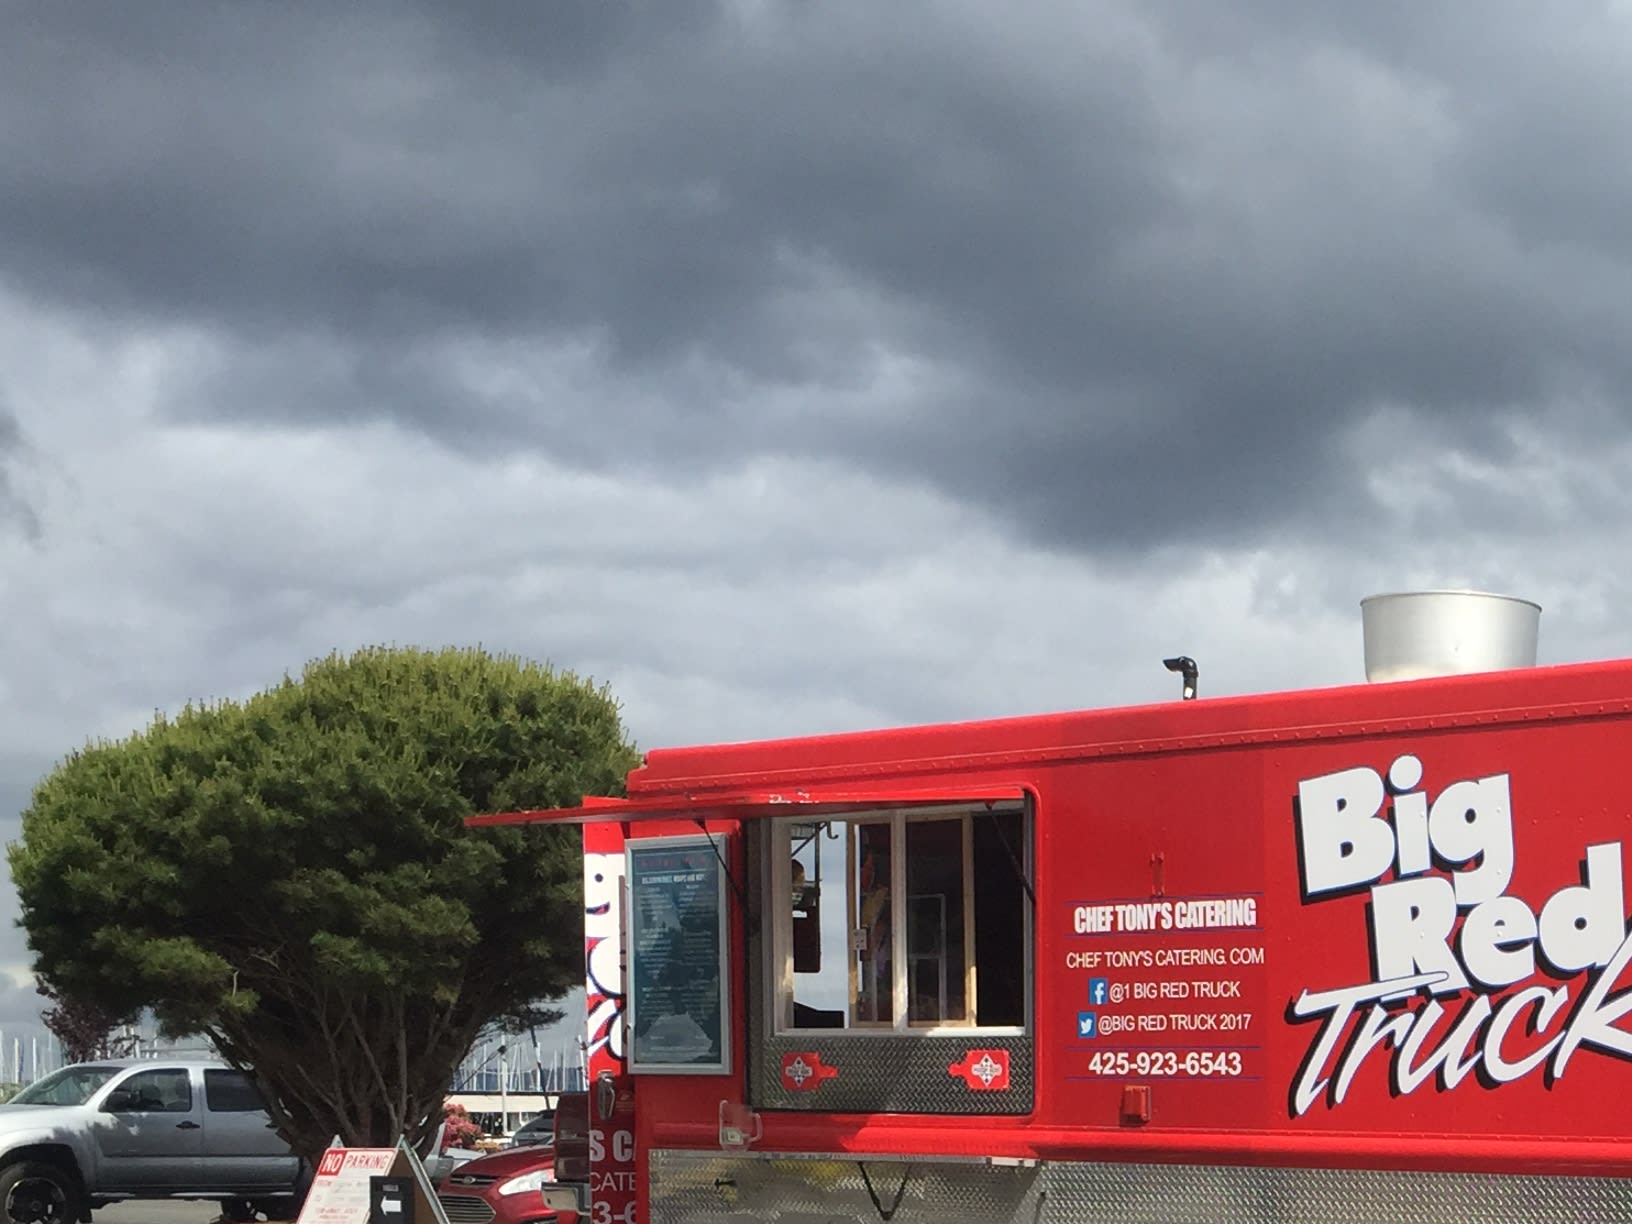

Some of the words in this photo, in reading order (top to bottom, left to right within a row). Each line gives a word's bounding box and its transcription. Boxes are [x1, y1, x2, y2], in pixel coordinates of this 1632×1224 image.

[1297, 754, 1514, 905] Big
[1074, 905, 1114, 934] CHEF
[1115, 902, 1173, 932] TONY'S
[1174, 897, 1257, 929] CATERING
[1370, 841, 1626, 1001] Red
[1066, 951, 1102, 968] CHEF
[1105, 950, 1153, 968] TONY'S
[1229, 948, 1265, 965] COM
[1133, 982, 1158, 999] BIG
[1160, 981, 1189, 999] RED
[1192, 980, 1241, 998] TRUCK
[1098, 1014, 1135, 1036] @BIG
[1138, 1014, 1167, 1031] RED
[1169, 1013, 1218, 1031] TRUCK
[1219, 1013, 1252, 1031] 2017
[1088, 1051, 1243, 1076] 425-923-6543
[612, 1129, 636, 1162] C
[321, 1153, 343, 1172] NO
[347, 1154, 389, 1169] PARKING
